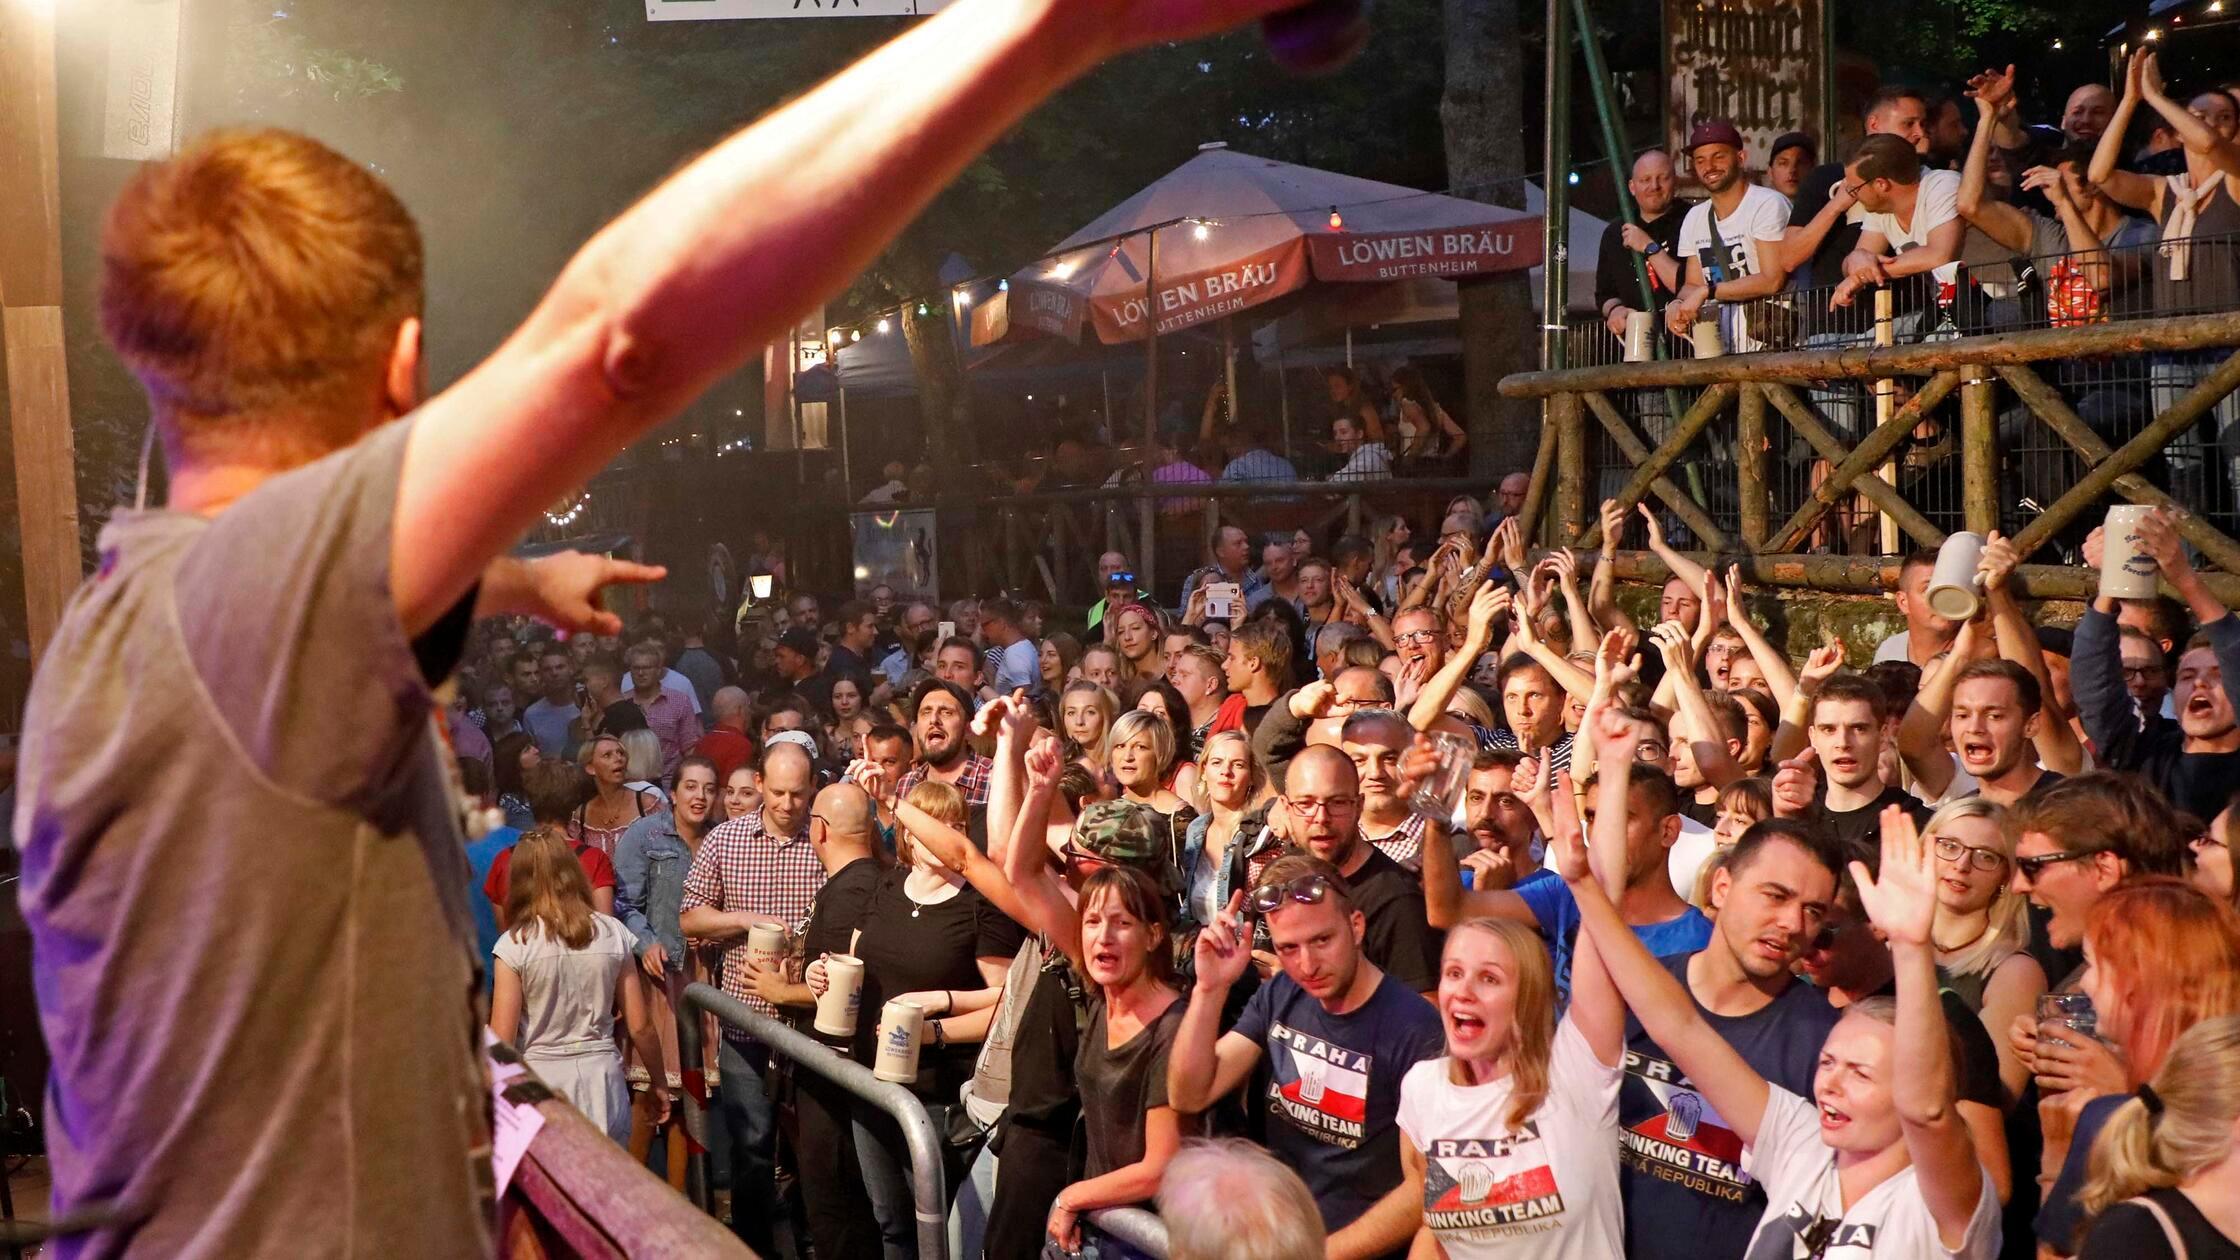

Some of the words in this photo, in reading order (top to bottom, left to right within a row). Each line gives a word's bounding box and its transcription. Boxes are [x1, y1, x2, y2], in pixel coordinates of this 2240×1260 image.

[1338, 236, 1435, 266] LÖWEN
[1443, 230, 1514, 255] BRÄU
[1205, 262, 1277, 298] BRÄU
[1379, 260, 1478, 278] BUTTENHEIM
[1156, 297, 1245, 333] UTTENHEIM
[1271, 1023, 1367, 1073] PRAHA
[1320, 1113, 1362, 1138] TEAM
[1652, 1165, 1745, 1203] REPUBLIKA
[1696, 1154, 1752, 1185] TEAM
[1424, 1207, 1497, 1230] RINKING
[1498, 1194, 1561, 1223] TEAM
